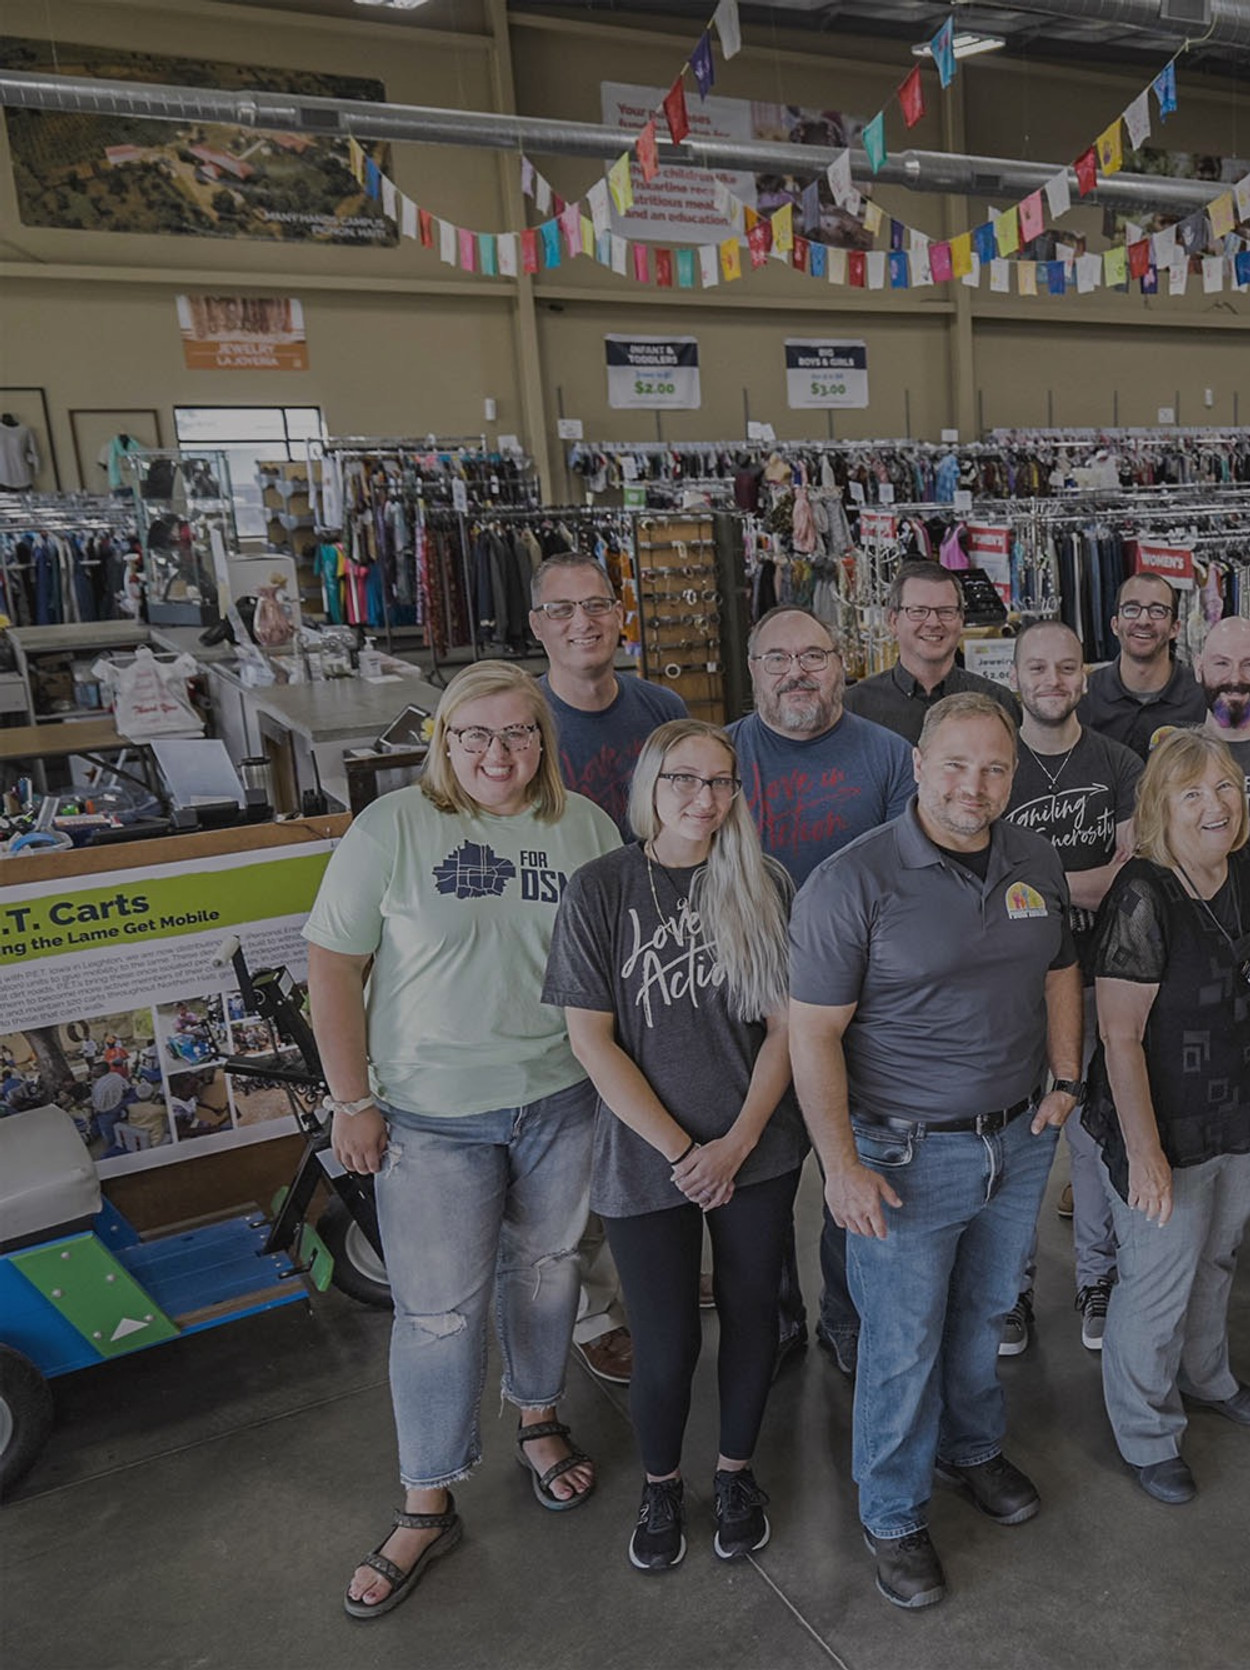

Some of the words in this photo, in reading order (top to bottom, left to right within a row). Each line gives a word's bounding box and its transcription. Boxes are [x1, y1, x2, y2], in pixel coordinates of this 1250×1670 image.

[634, 380, 676, 395] $2.00
[811, 381, 847, 397] $3.00
[520, 850, 548, 869] FOR
[50, 893, 150, 927] Carts
[31, 935, 64, 953] the
[68, 926, 119, 945] Lame
[122, 919, 157, 935] Get
[159, 909, 221, 929] Mobile
[621, 907, 703, 979] Love
